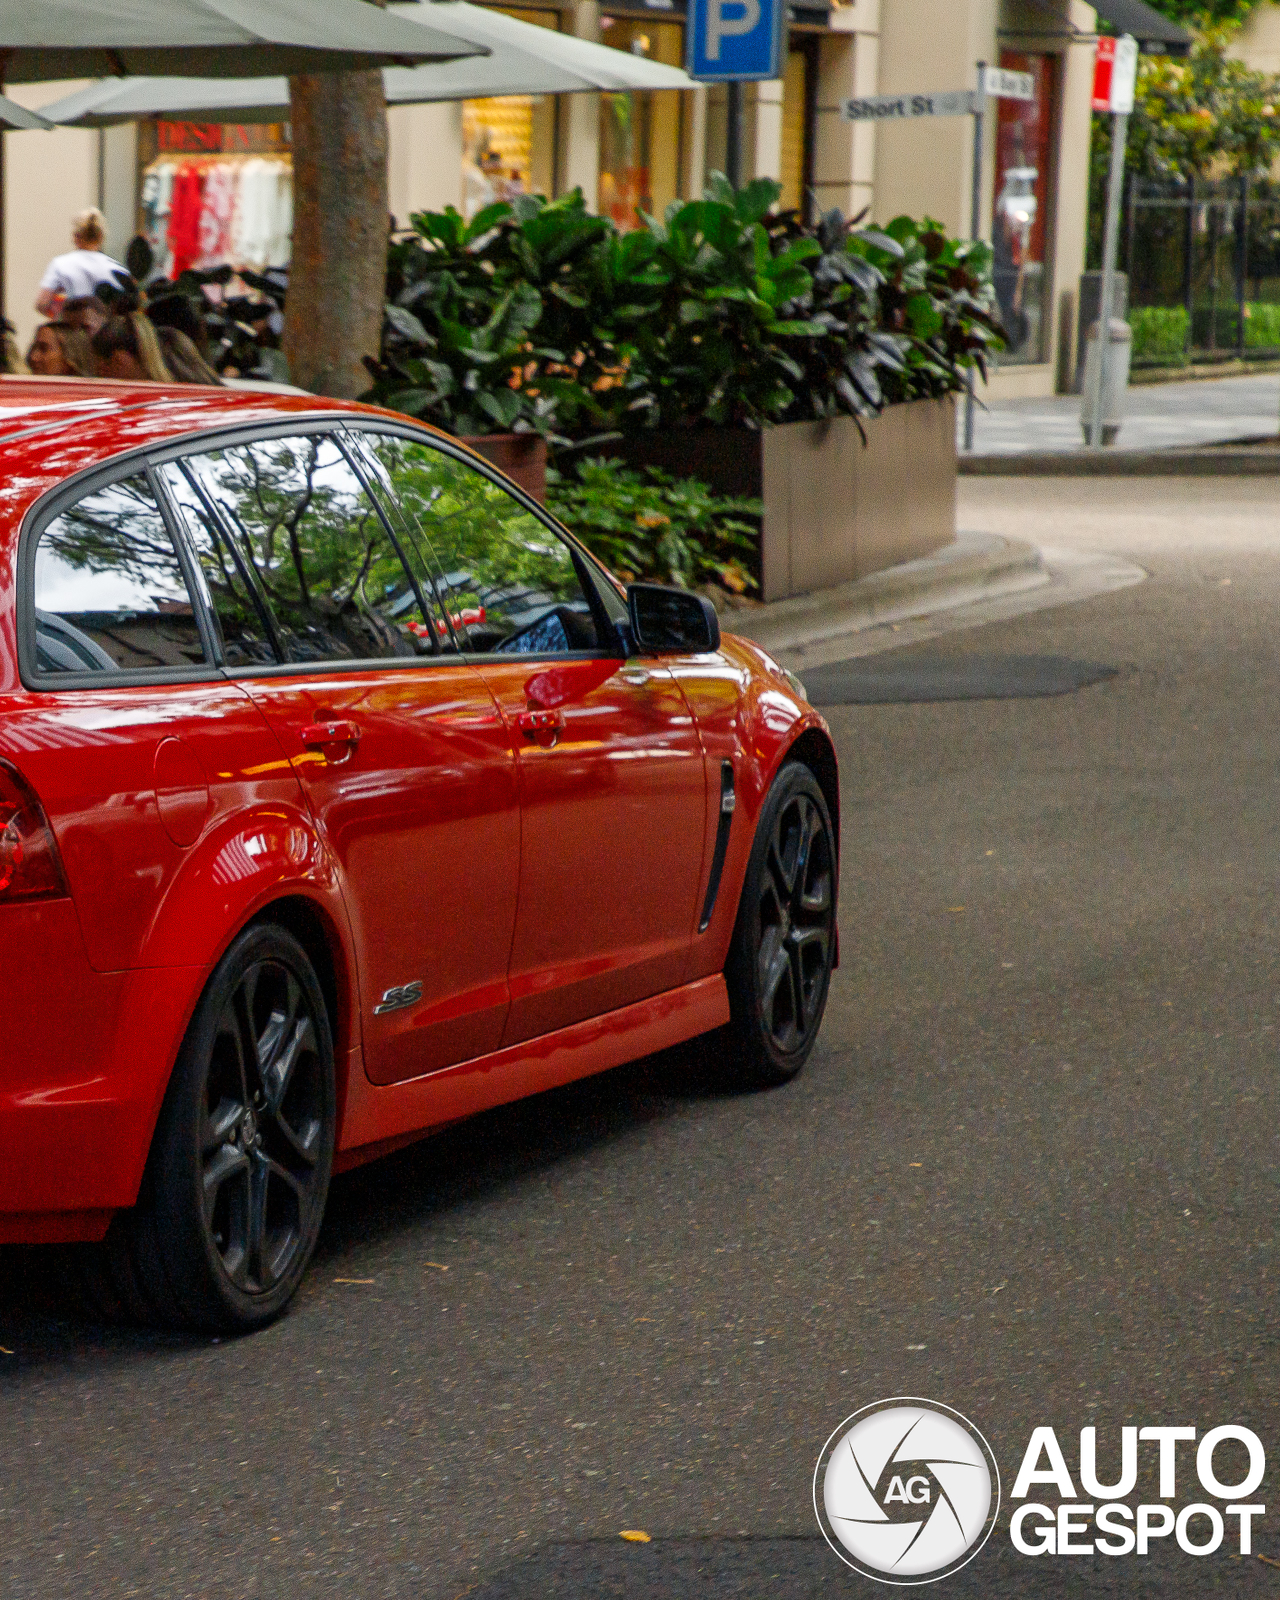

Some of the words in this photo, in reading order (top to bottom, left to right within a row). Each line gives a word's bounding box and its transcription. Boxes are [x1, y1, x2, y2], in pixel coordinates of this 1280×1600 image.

[705, 0, 761, 60] P
[847, 100, 904, 119] Short
[911, 95, 934, 116] St
